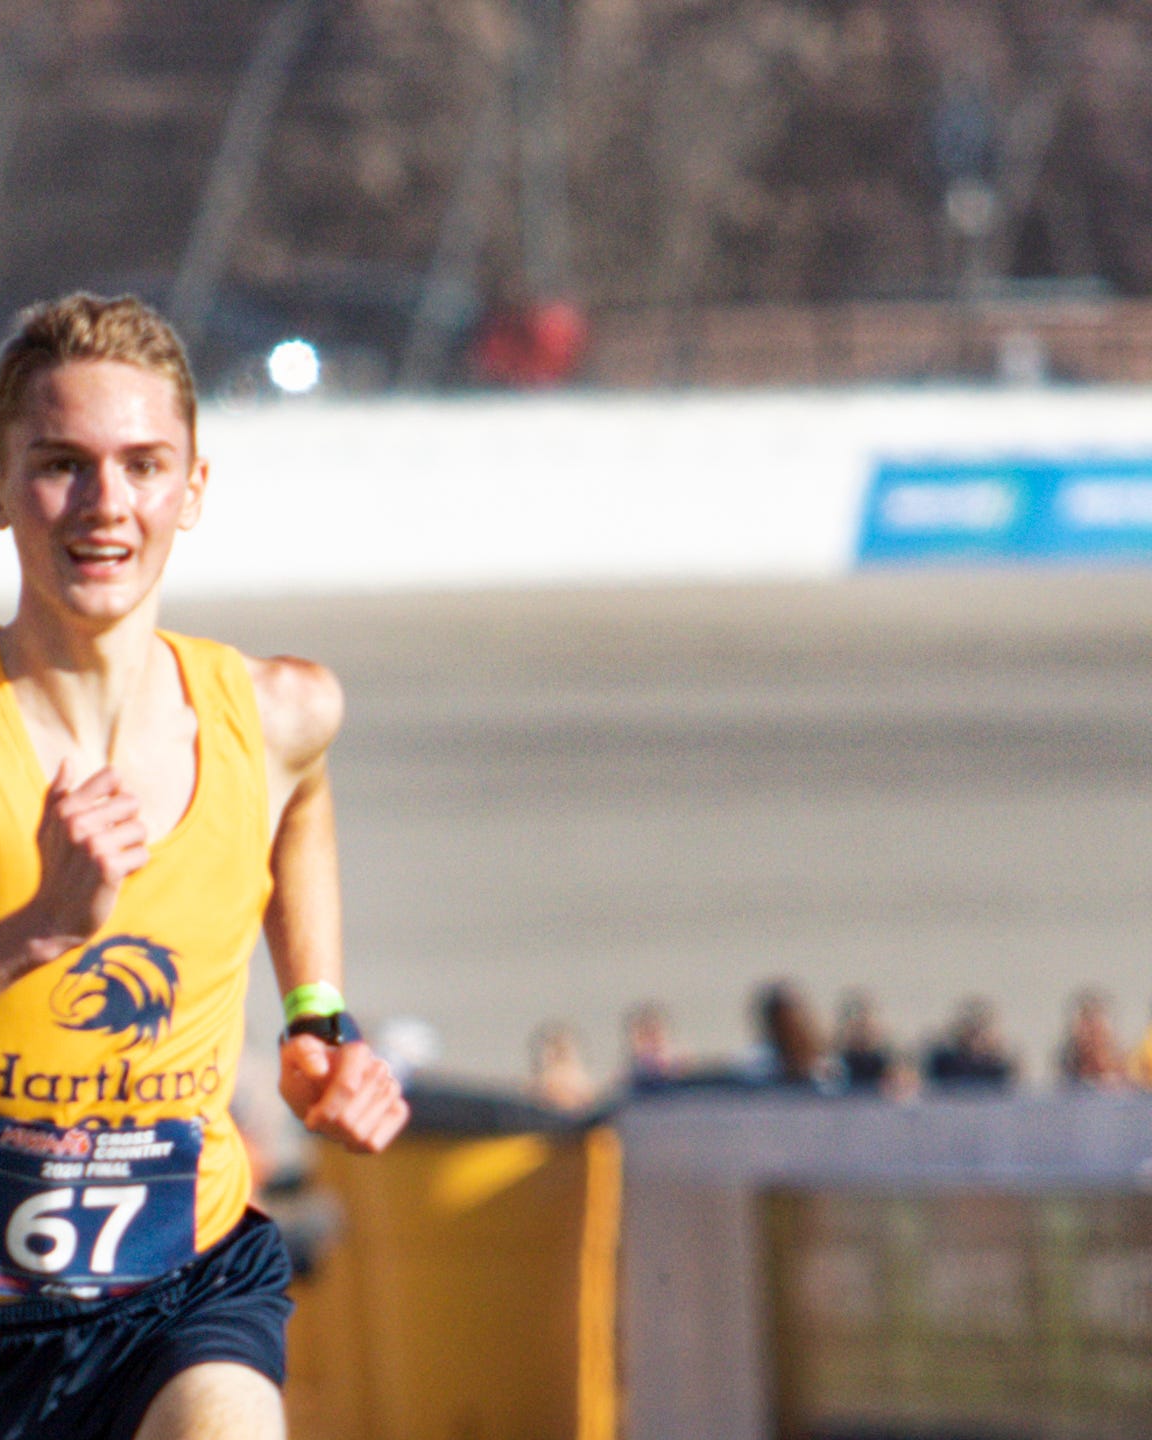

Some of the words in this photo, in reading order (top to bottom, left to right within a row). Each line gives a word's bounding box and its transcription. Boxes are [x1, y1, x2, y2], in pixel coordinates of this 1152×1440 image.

[93, 1141, 174, 1160] COUNTRY
[85, 1161, 132, 1179] FINAL
[5, 1184, 148, 1274] 67
